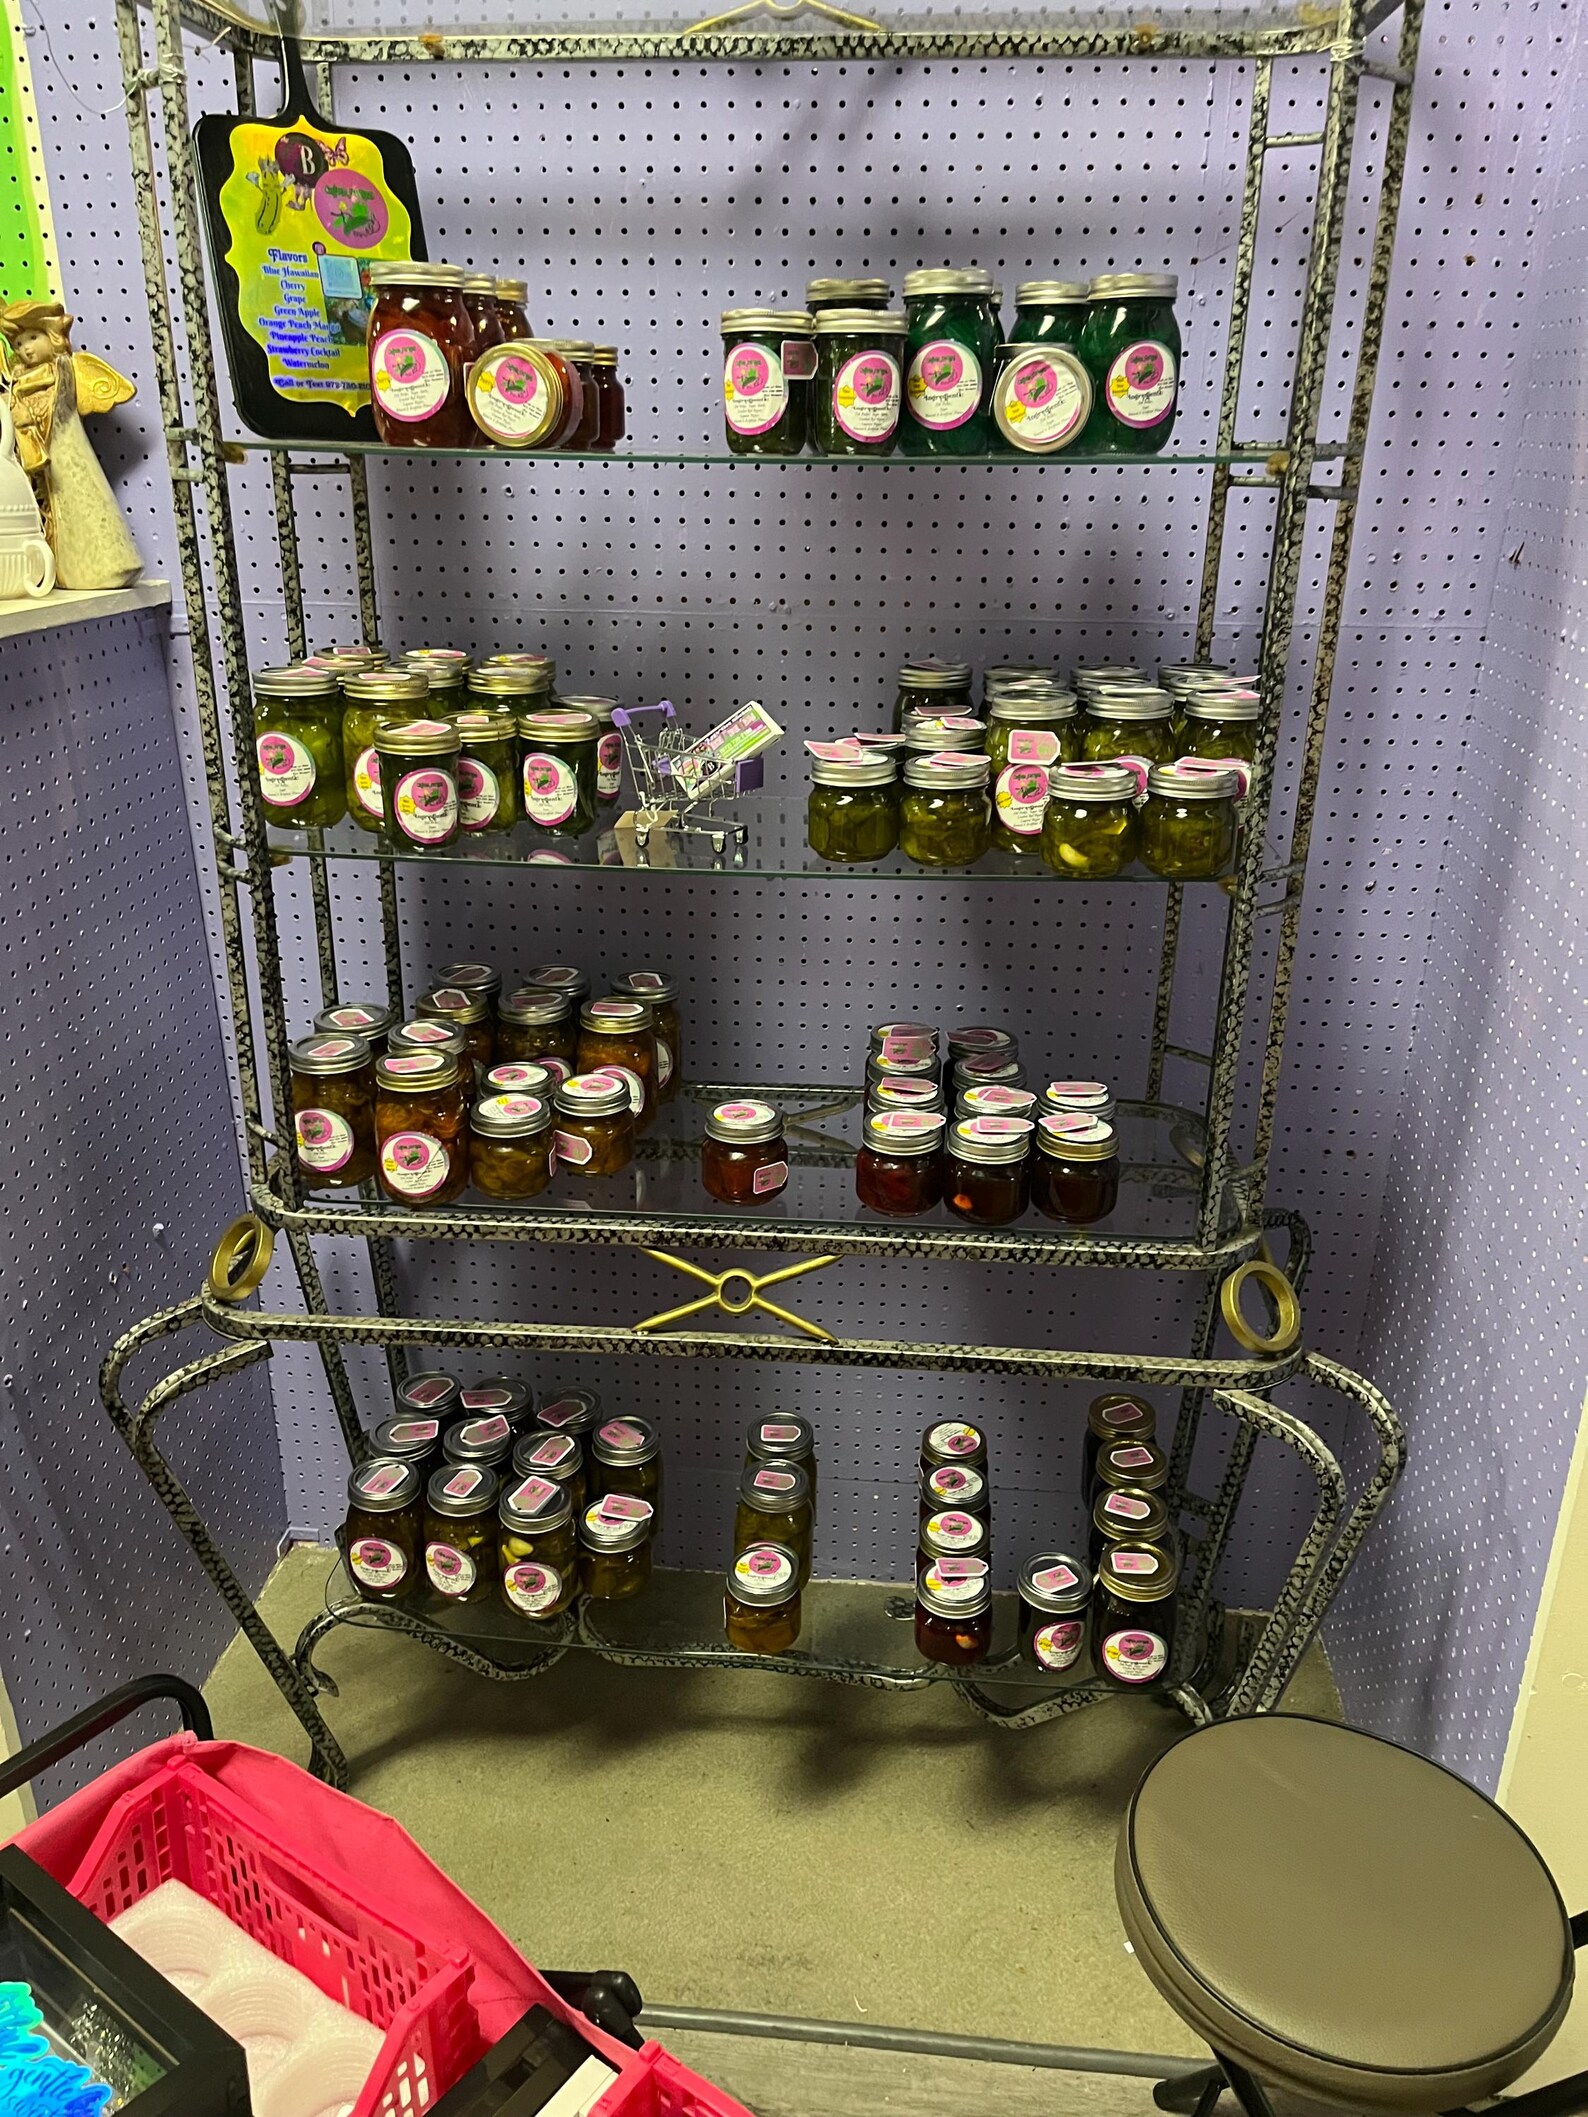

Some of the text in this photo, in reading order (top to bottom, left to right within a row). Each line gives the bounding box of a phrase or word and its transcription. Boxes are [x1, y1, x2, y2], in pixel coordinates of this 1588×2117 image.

[301, 145, 316, 175] B
[268, 248, 308, 263] Flavors
[262, 265, 319, 279] Blue Hawaiian
[280, 279, 305, 291] Cherry
[284, 293, 306, 305] Grape
[274, 305, 320, 318] Green Apple
[258, 317, 340, 334] Orange Peach Mango
[269, 331, 335, 344] Pineapple Peach
[266, 344, 340, 358] Strawberry Cocktail
[282, 358, 330, 369] Watermelon
[273, 378, 294, 388] Call
[305, 379, 323, 389] Text
[1, 2064, 83, 2101] gentle
